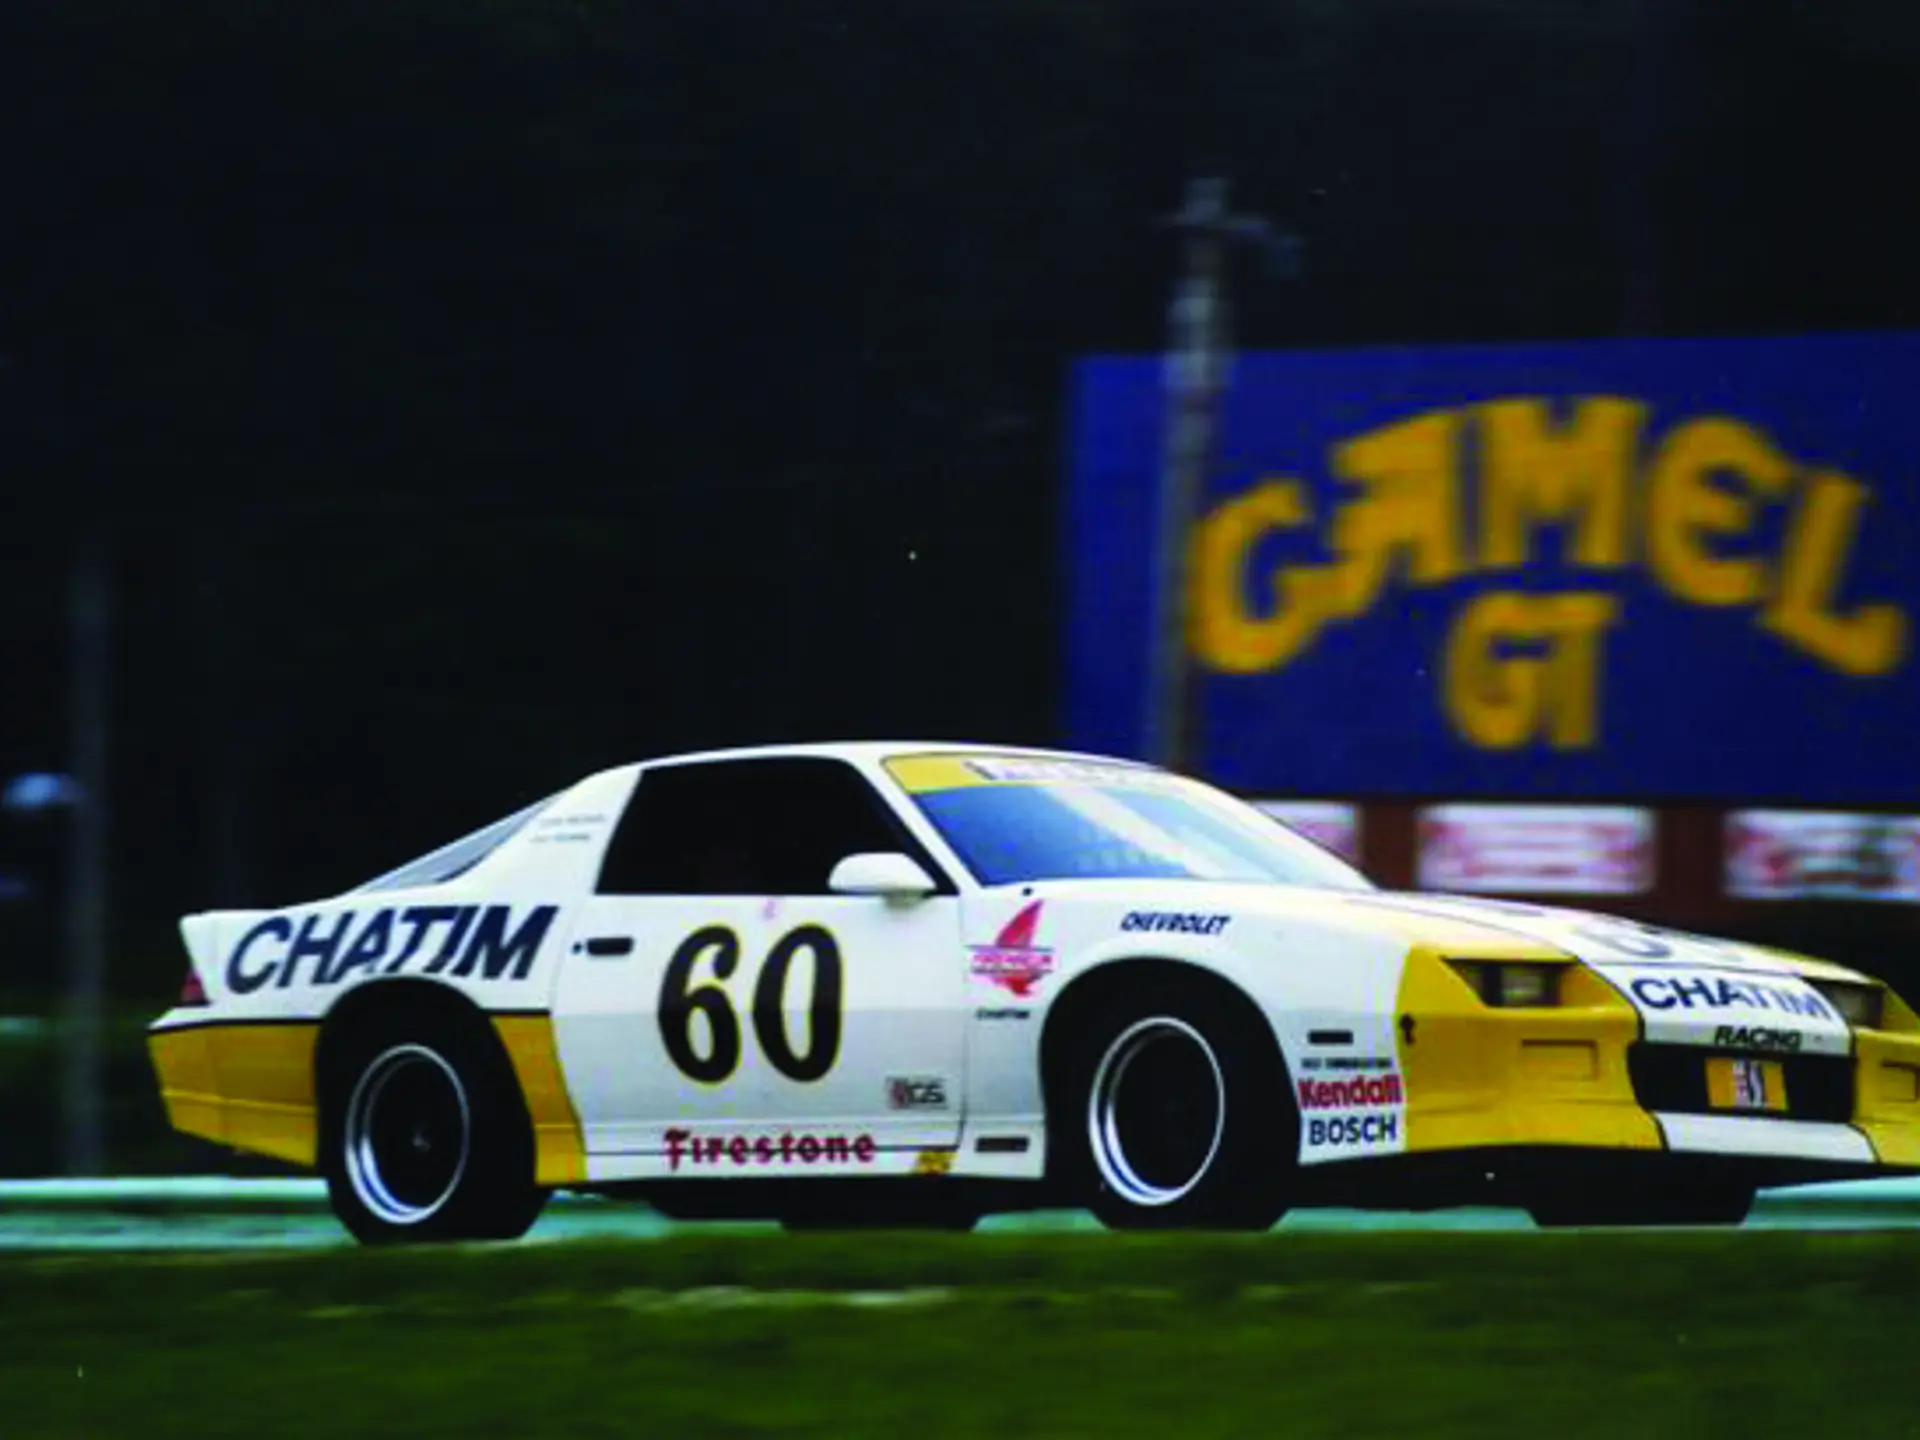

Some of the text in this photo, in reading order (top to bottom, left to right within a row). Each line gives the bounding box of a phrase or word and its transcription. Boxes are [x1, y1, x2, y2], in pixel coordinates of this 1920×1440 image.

[1189, 396, 1906, 674] CAMEL
[1444, 591, 1620, 752] GT
[1120, 911, 1230, 934] CHEVROLET
[226, 905, 559, 994] CHATIM
[659, 922, 842, 1086] 60
[1631, 978, 1831, 1022] CHATIM
[1714, 1025, 1802, 1047] RACING
[1298, 1074, 1403, 1107] Kendall
[663, 1128, 875, 1170] Firestone
[1309, 1115, 1397, 1145] BOSCH
